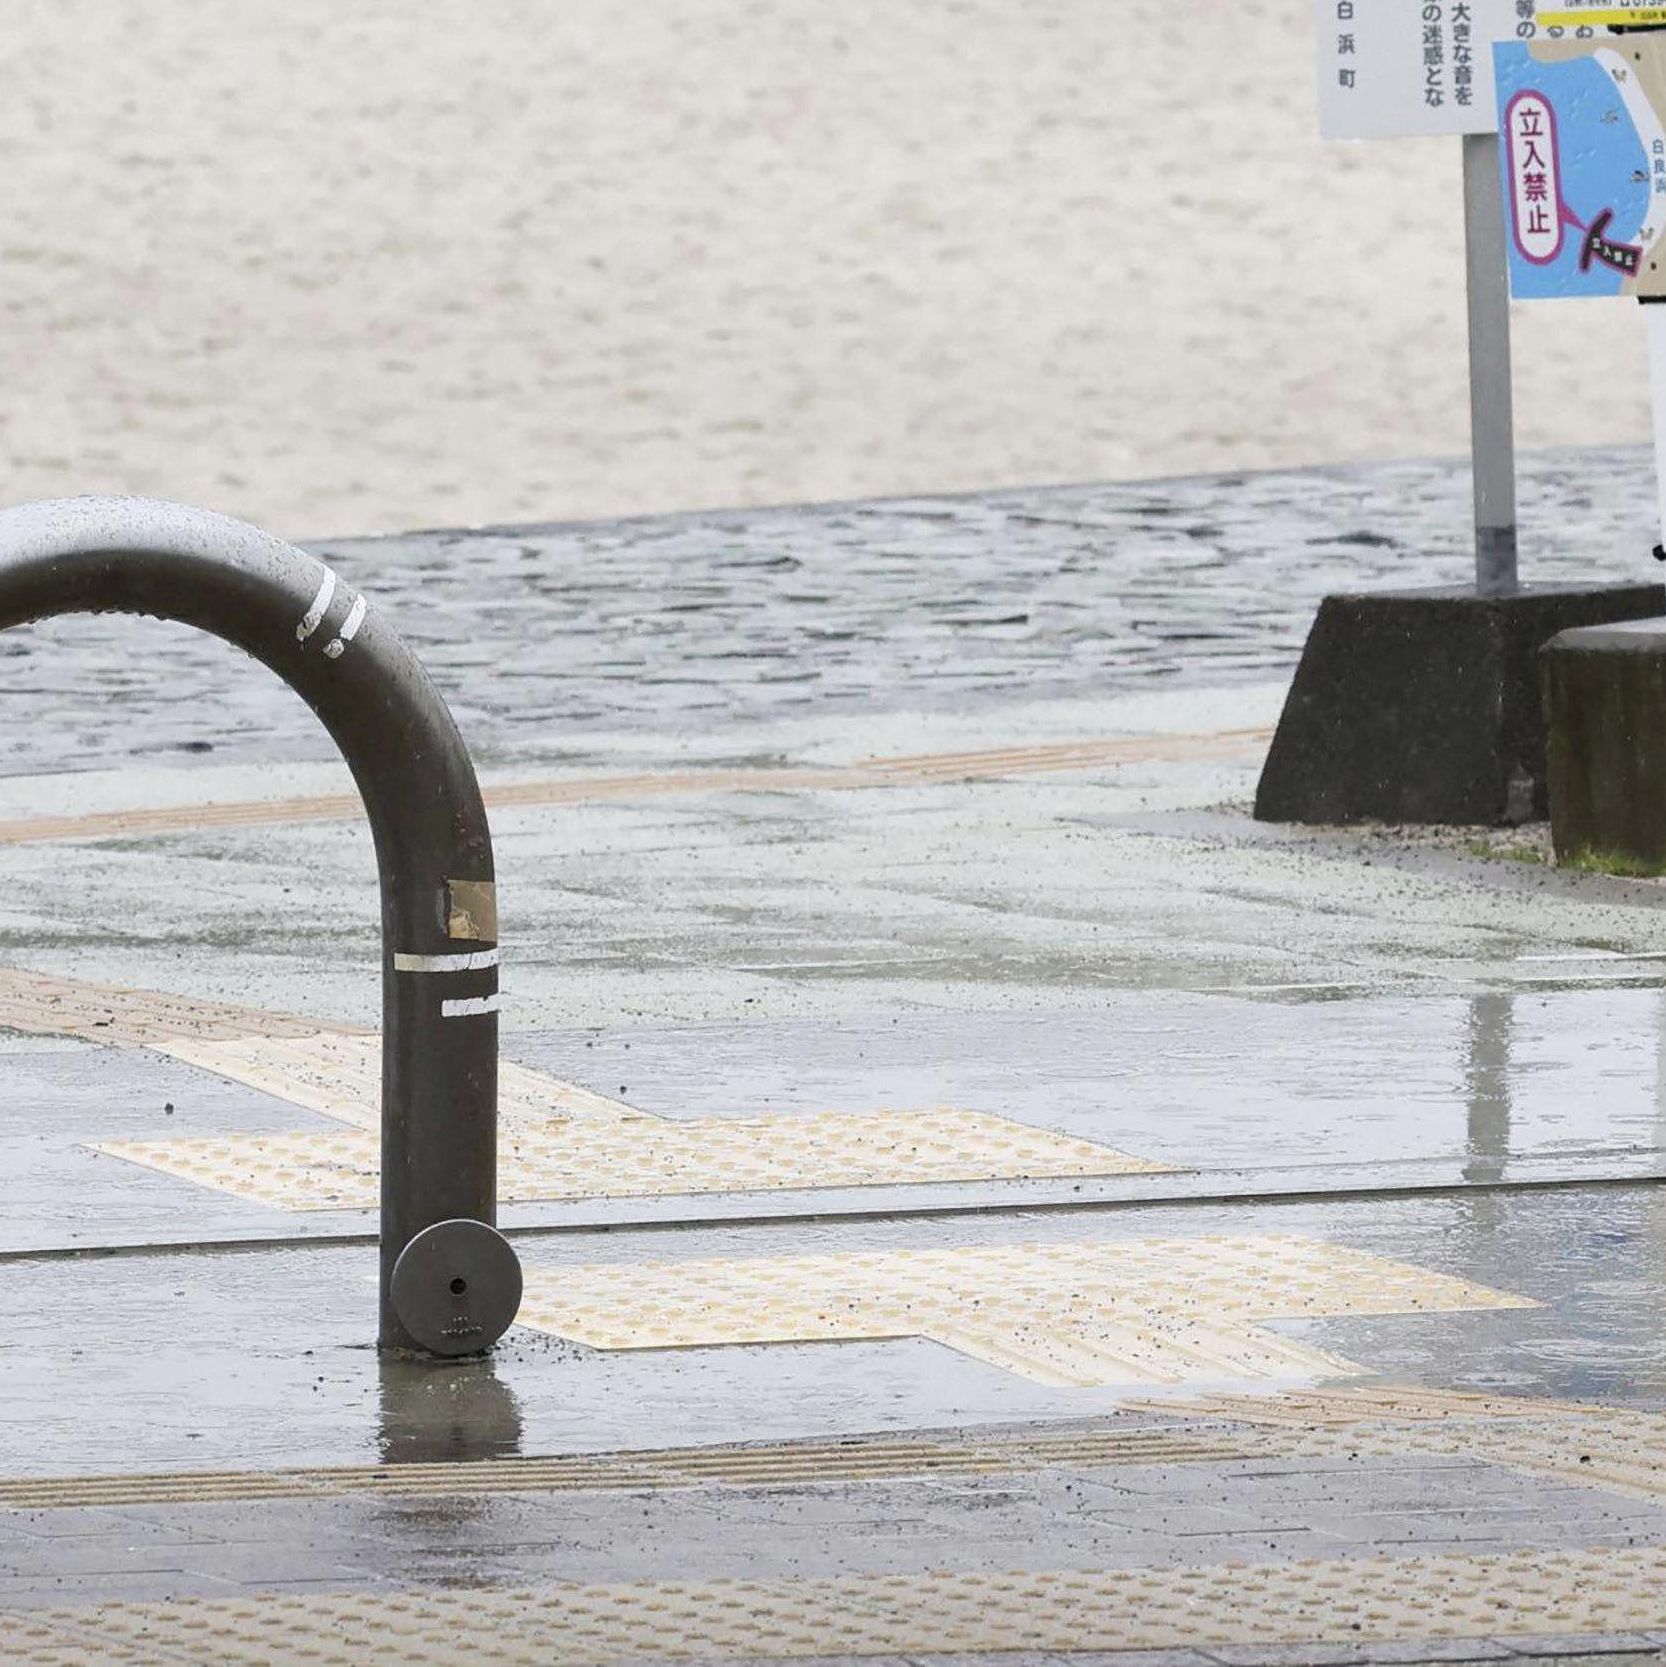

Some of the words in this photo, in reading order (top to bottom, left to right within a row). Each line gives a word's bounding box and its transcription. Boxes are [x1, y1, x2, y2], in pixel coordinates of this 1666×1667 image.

[1337, 0, 1355, 88] 白浜町
[1519, 108, 1551, 234] 立入禁止
